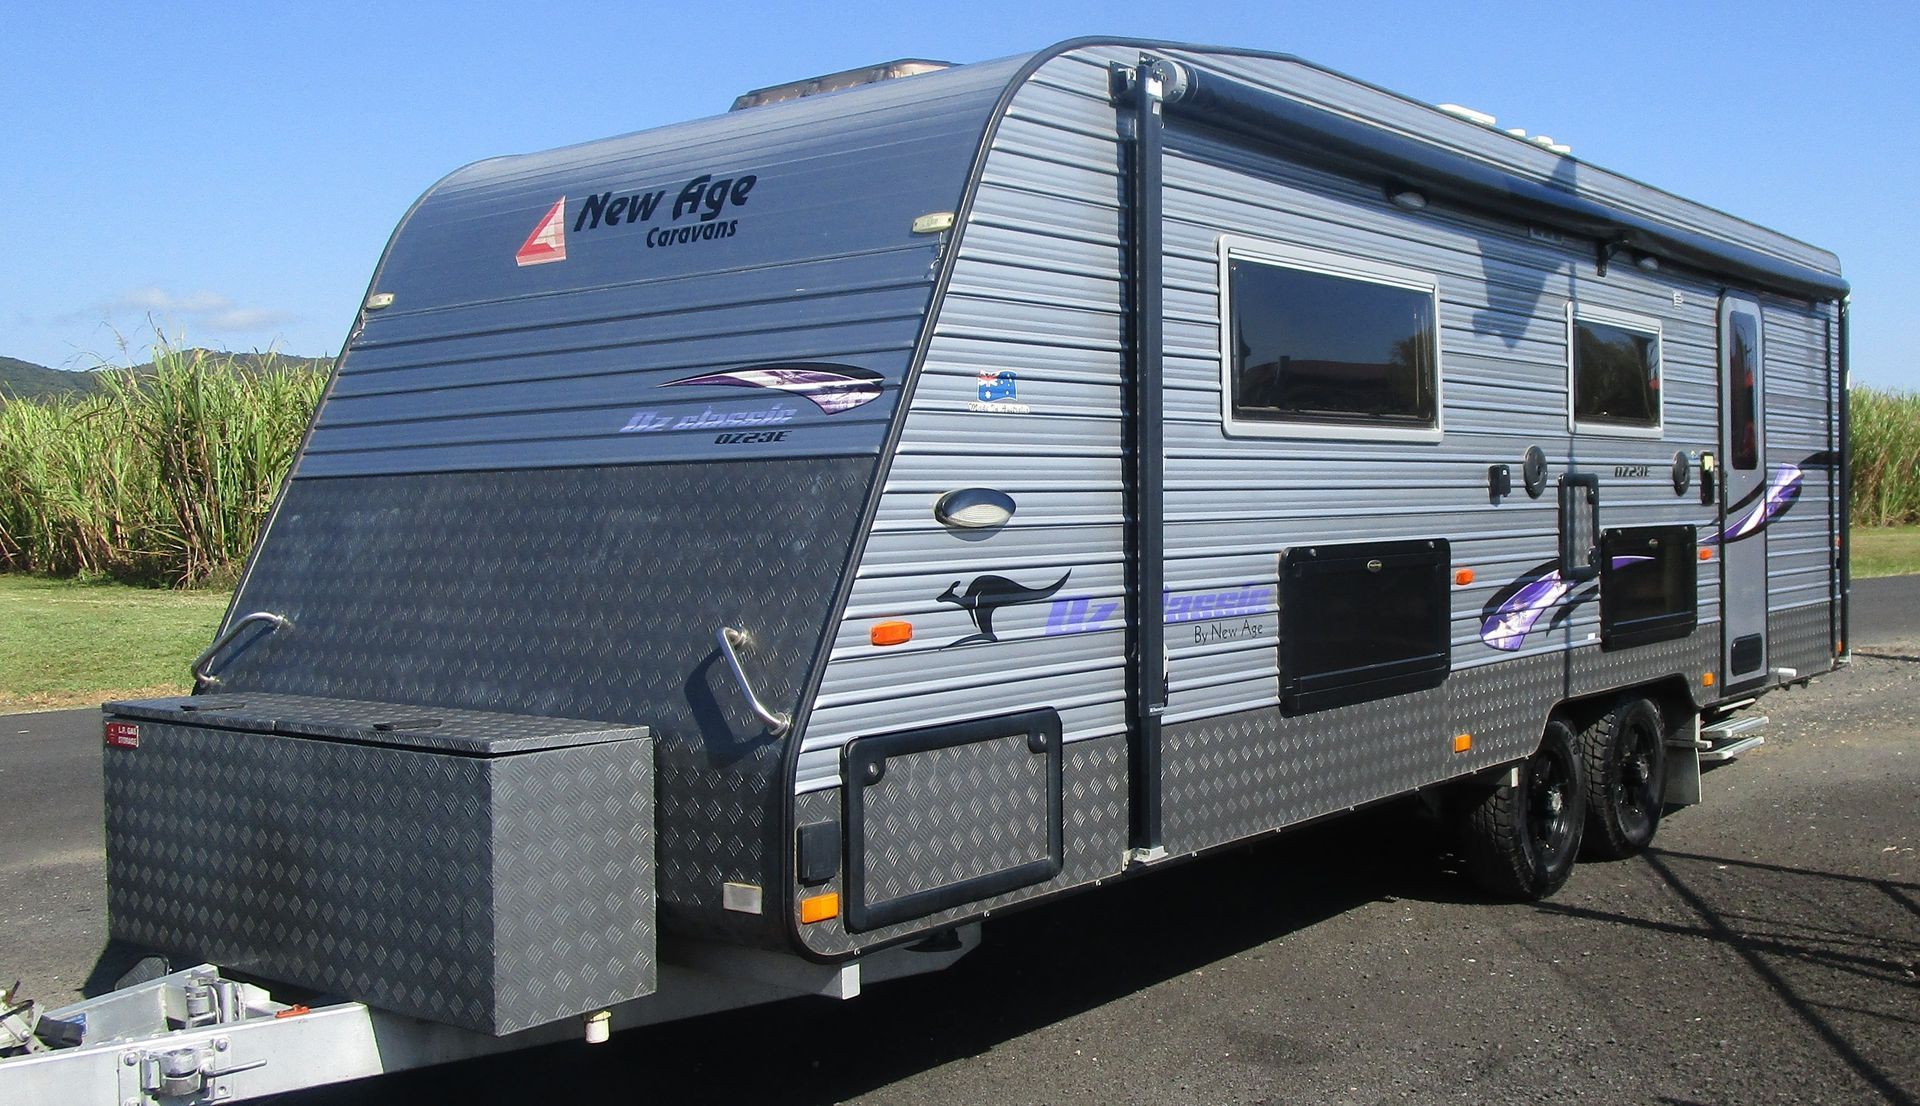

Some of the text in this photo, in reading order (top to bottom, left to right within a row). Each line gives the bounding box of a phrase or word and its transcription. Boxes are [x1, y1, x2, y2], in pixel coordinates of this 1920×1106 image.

[574, 174, 757, 232] New Age
[646, 220, 738, 248] Caravans
[672, 403, 797, 430] classic
[714, 430, 792, 444] OZ23E
[1194, 619, 1263, 645] By New Age
